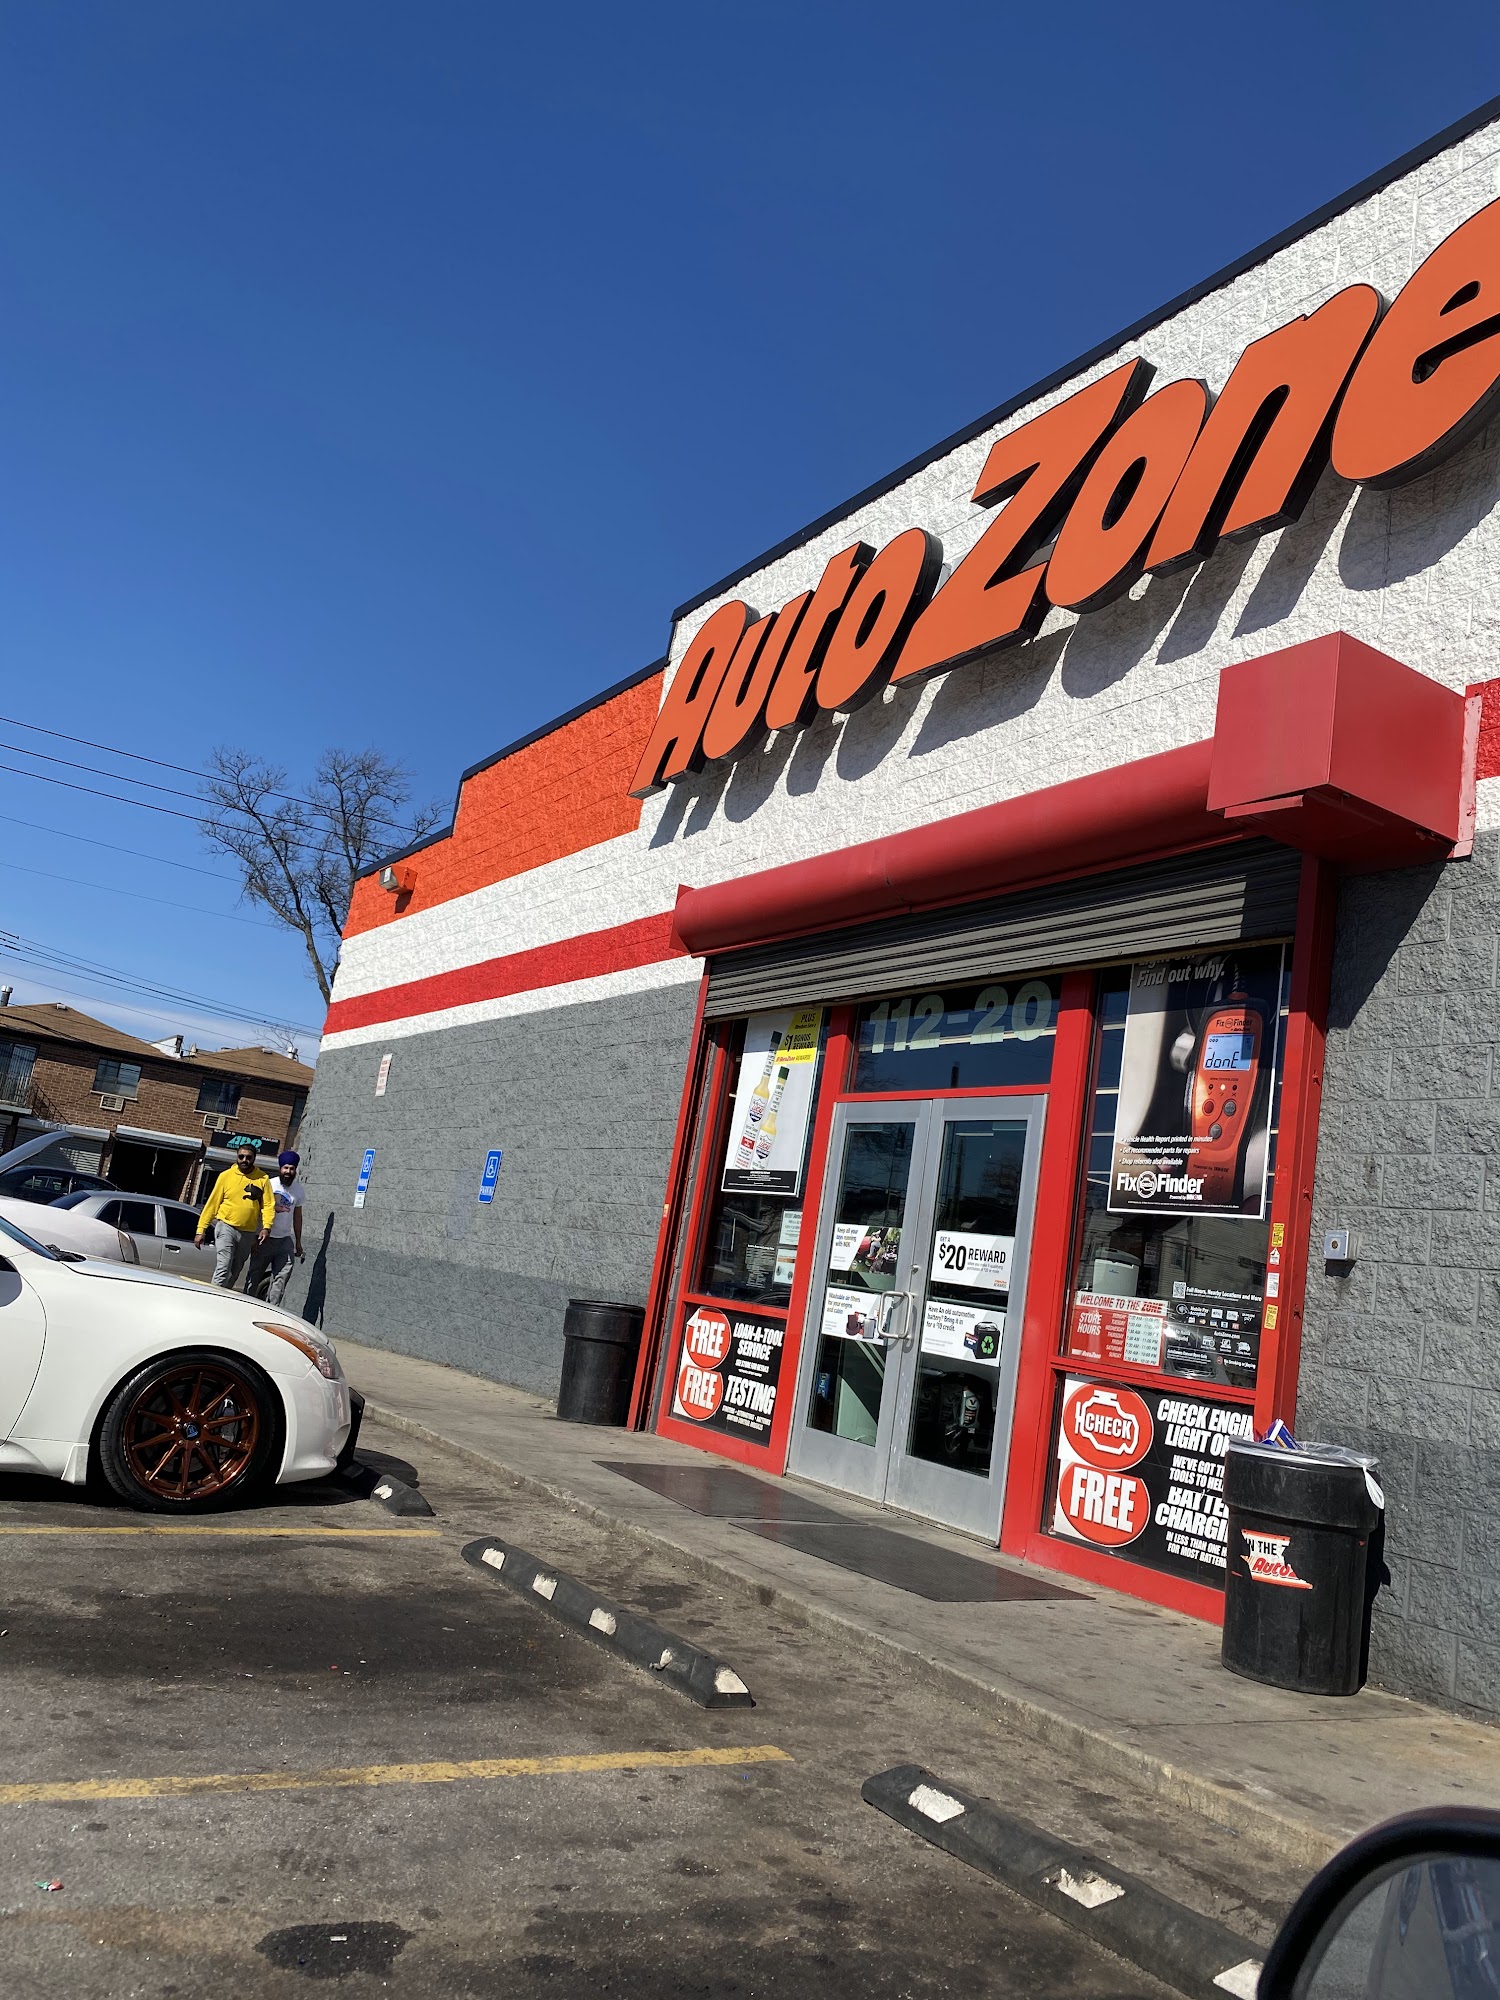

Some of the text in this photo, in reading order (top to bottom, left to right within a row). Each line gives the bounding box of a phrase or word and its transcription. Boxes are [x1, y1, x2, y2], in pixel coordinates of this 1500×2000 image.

[628, 197, 1500, 799] AutoZone
[1137, 968, 1166, 987] Find
[1168, 965, 1191, 982] out
[1195, 961, 1225, 981] why.
[801, 1013, 816, 1023] PLUS
[869, 981, 1052, 1054] 112-20
[785, 1034, 793, 1052] $1
[794, 1034, 811, 1042] BONUS
[1205, 1051, 1239, 1068] donE
[1162, 1147, 1175, 1155] parts
[1117, 1173, 1204, 1193] Fix Finder
[939, 1243, 1006, 1271] $20 REWARD
[1080, 1294, 1165, 1313] WELCOME TO THE ZONE
[1077, 1324, 1101, 1335] HOURS
[1079, 1312, 1102, 1324] STORE
[690, 1319, 726, 1358] FREE
[733, 1322, 784, 1346] LOAN-A-TOOL
[683, 1366, 718, 1410] FREE
[724, 1375, 776, 1415] TESTING
[1085, 1412, 1133, 1440] CHECK
[1157, 1399, 1254, 1442] CHECK ENGIN
[1164, 1424, 1211, 1453] LIGHT
[1172, 1454, 1198, 1472] WE'VE
[1197, 1460, 1217, 1475] GOT
[1169, 1467, 1224, 1492] TOOLS TO HEL
[1069, 1466, 1137, 1533] FREE
[1167, 1486, 1229, 1519] BATTE
[1155, 1503, 1229, 1543] CHARGI
[1166, 1531, 1174, 1540] IN
[1174, 1533, 1189, 1546] LESS
[1190, 1538, 1207, 1551] THAN
[1207, 1542, 1221, 1555] ONE
[1167, 1542, 1180, 1554] FOR
[1180, 1546, 1200, 1560] MOST
[1199, 1551, 1227, 1568] BATTER
[1258, 1540, 1277, 1555] THE
[1252, 1558, 1297, 1578] Auto
